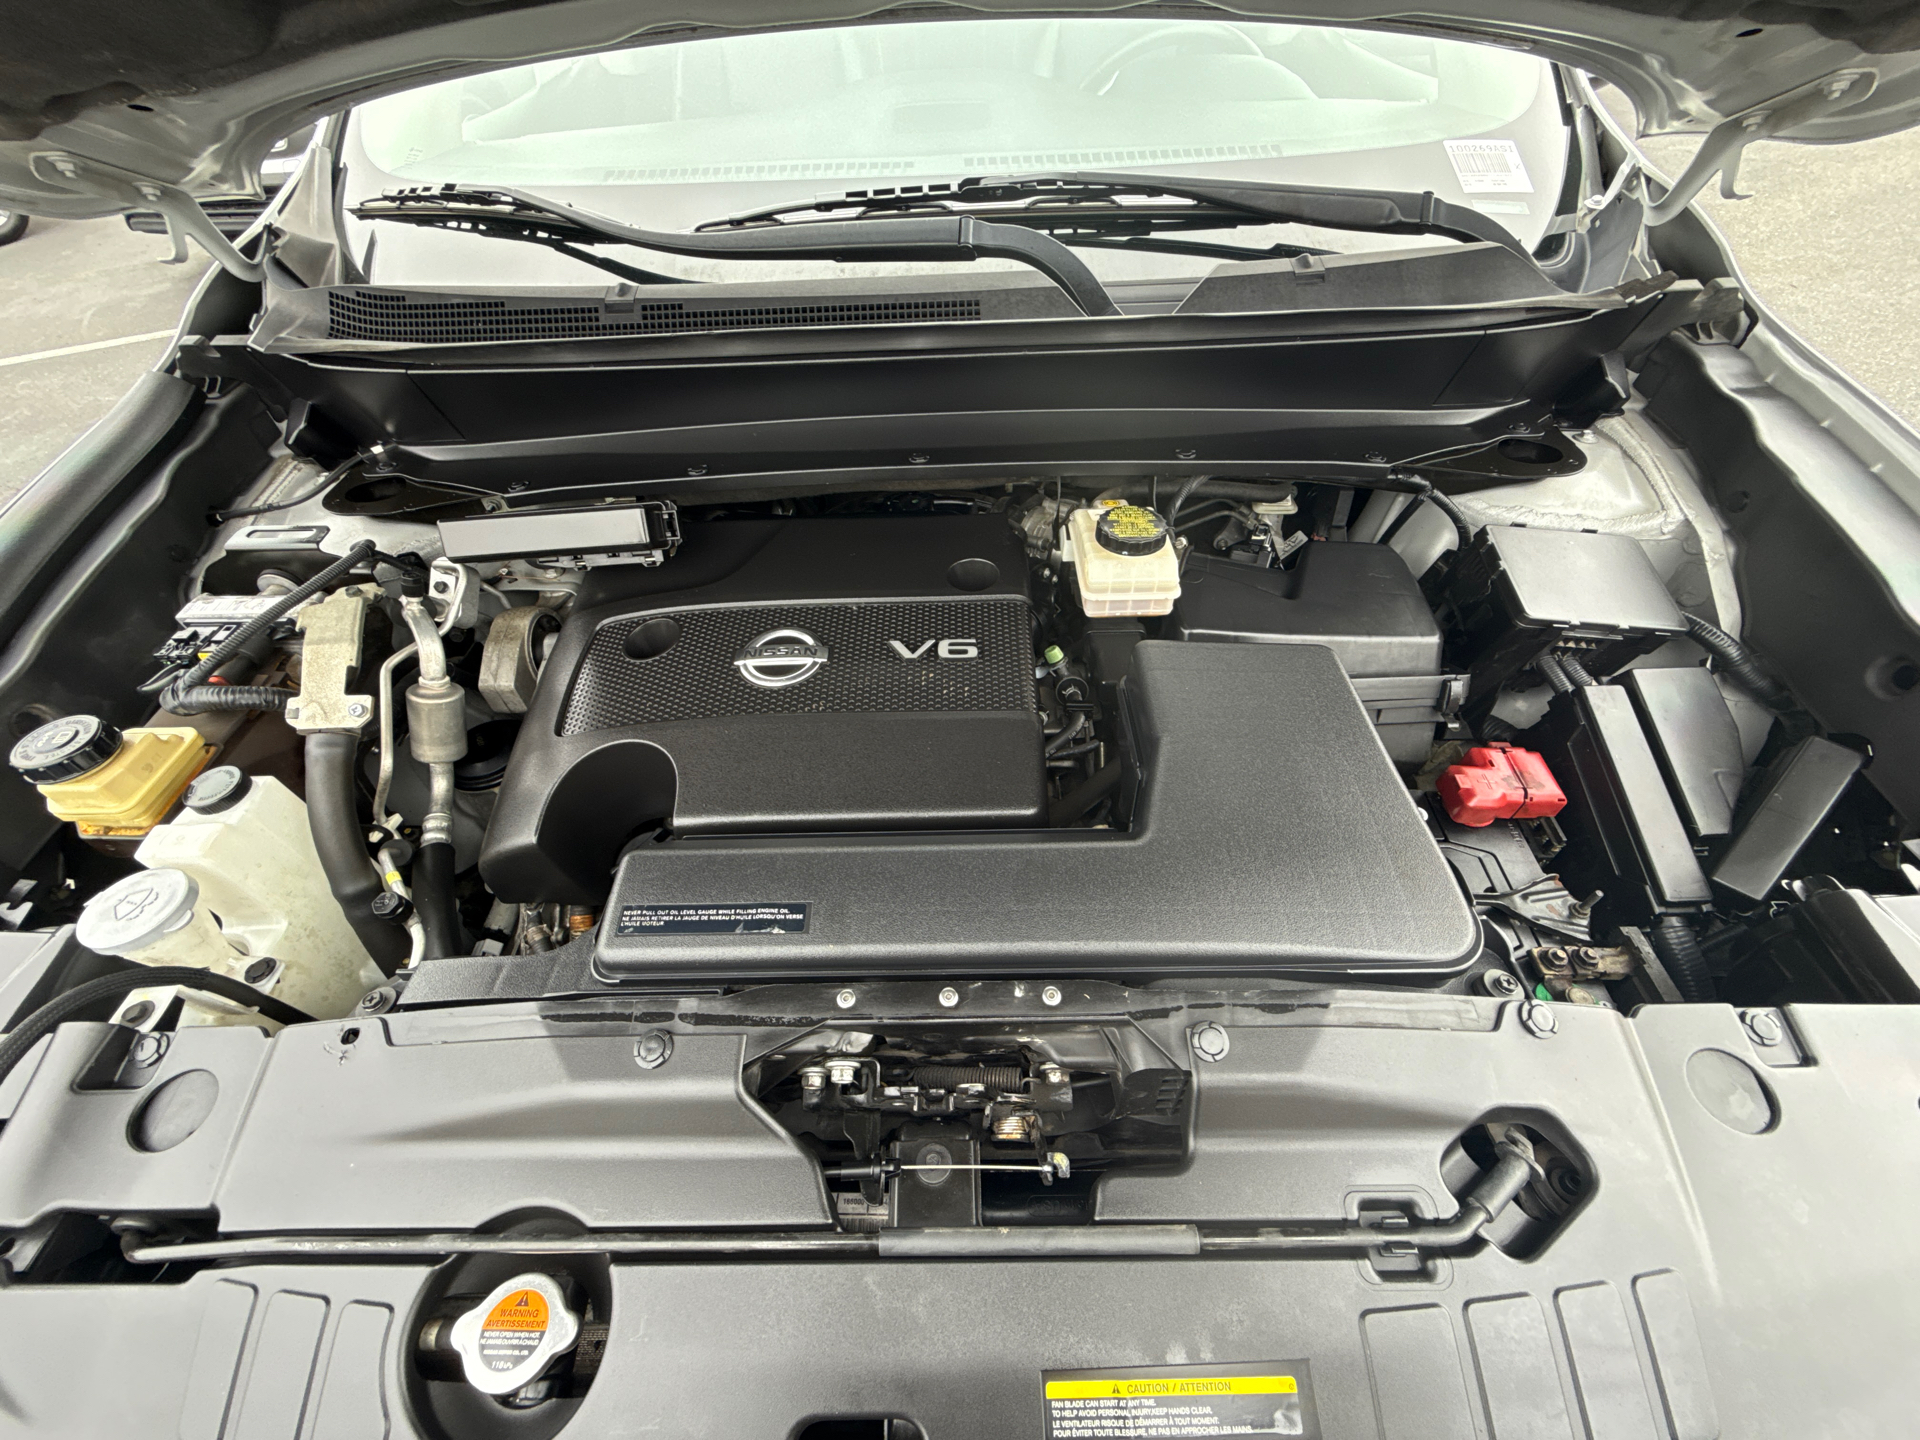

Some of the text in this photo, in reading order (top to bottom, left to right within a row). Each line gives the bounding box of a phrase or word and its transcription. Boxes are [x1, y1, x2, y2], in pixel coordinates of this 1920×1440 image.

[743, 646, 819, 659] NISSAN
[888, 638, 979, 663] V6
[500, 1308, 539, 1318] WARNING
[486, 1319, 546, 1328] AVERTISSEMENT
[1127, 1383, 1169, 1394] CAUTION
[1179, 1382, 1231, 1392] ATTENTION
[1065, 1400, 1084, 1408] BLADE
[1078, 1409, 1097, 1417] AVOID
[1098, 1408, 1131, 1417] PERSONAL
[1191, 1406, 1213, 1414] CLEAR.
[1061, 1420, 1100, 1428] VENTILATEUR
[1101, 1419, 1124, 1427] RISQUE
[1135, 1417, 1168, 1426] DÉMARRER
[1169, 1416, 1174, 1425] À
[1192, 1417, 1220, 1425] MOMENT.
[1053, 1429, 1071, 1437] POUR
[1072, 1428, 1093, 1437] ÉVITER
[1171, 1427, 1180, 1435] EN
[1181, 1426, 1220, 1434] APPROCHER
